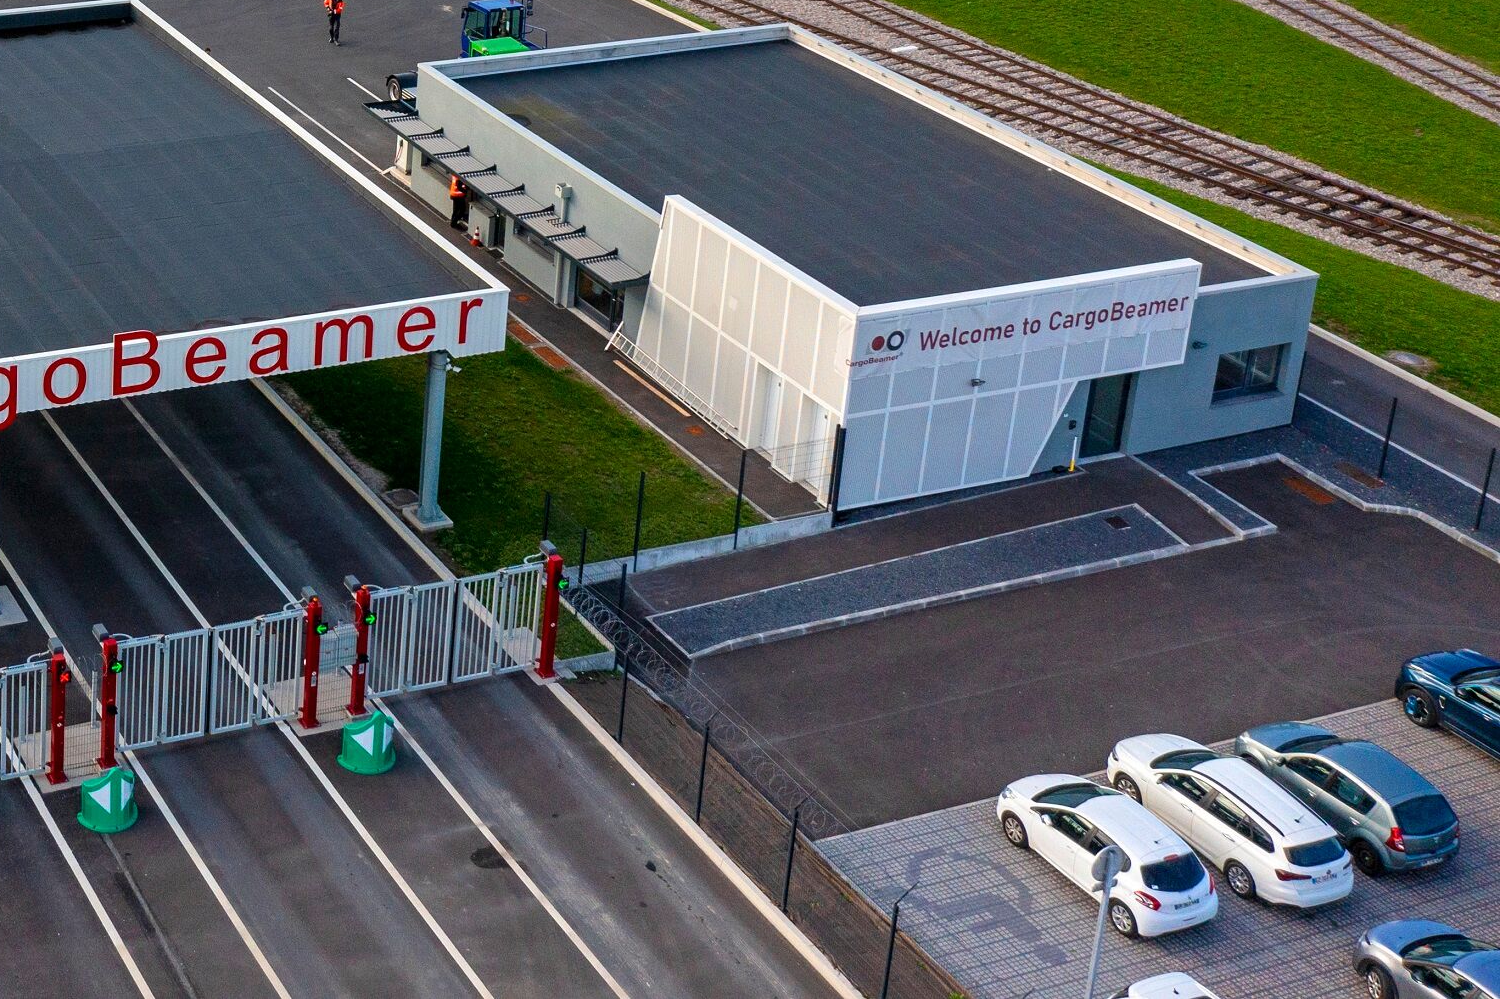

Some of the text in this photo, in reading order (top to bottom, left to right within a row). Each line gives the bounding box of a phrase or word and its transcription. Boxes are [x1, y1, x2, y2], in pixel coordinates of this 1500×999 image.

[919, 295, 1190, 352] Welcome to CargoBeamer
